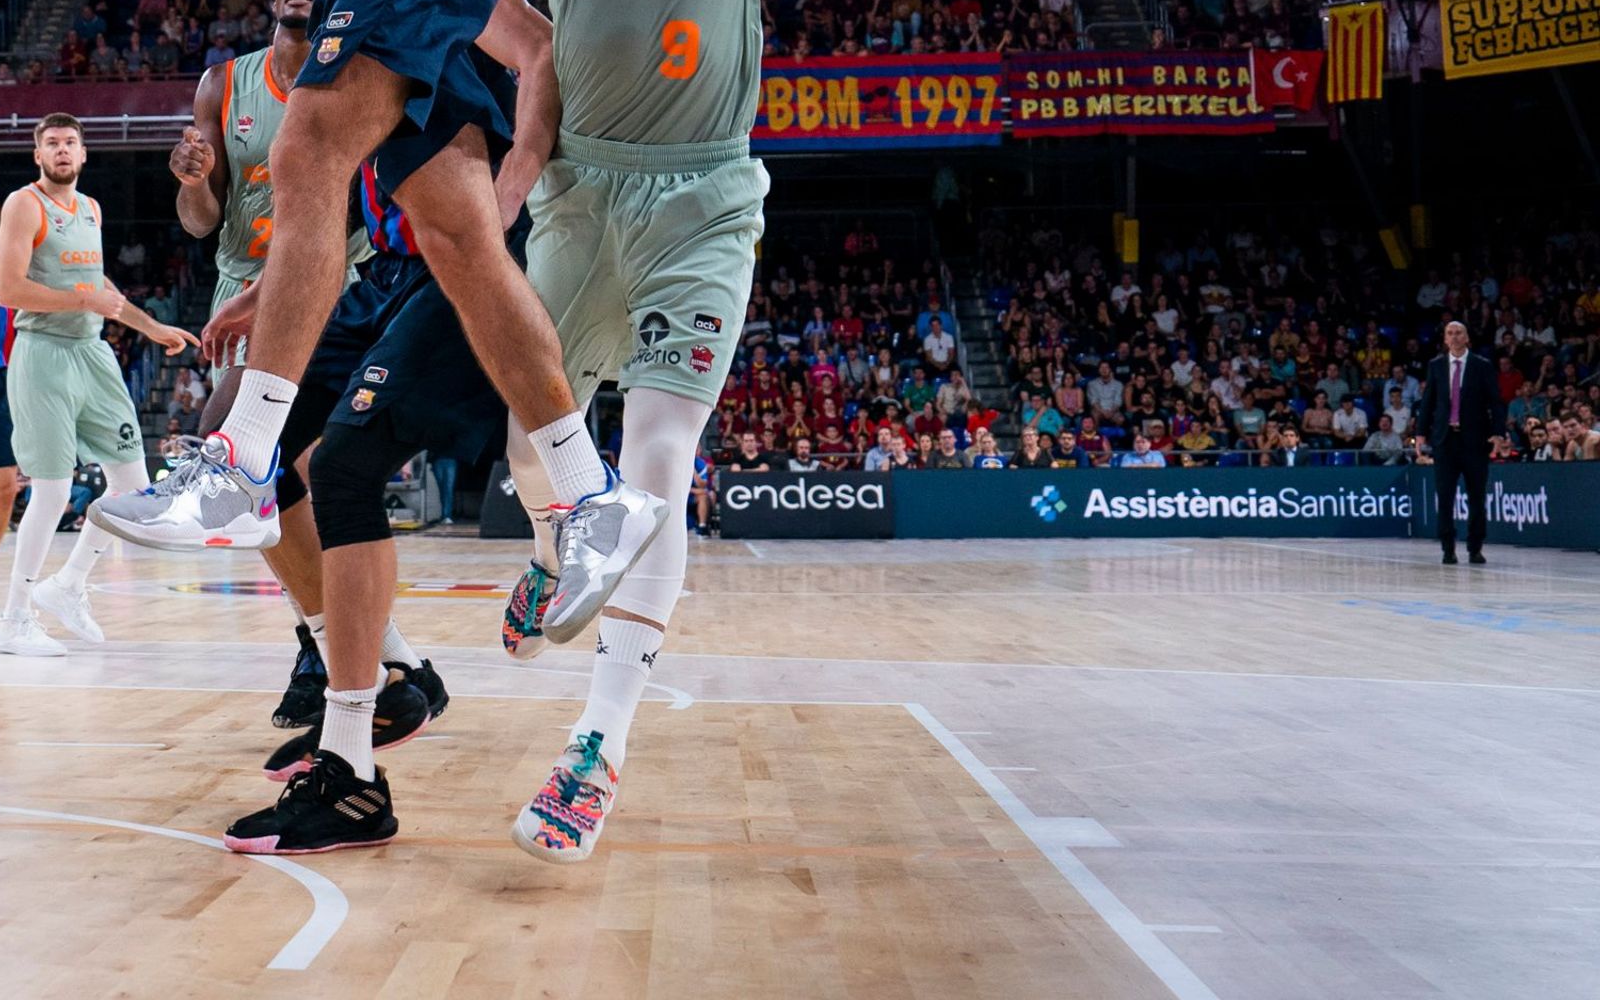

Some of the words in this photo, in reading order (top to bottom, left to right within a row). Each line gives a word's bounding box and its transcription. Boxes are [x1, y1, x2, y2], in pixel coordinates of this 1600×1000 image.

[1026, 67, 1124, 90] SOM-HI
[1153, 66, 1250, 89] BARÇA
[758, 76, 861, 131] BBM
[895, 76, 997, 129] 1997
[1021, 97, 1079, 120] PBB
[1086, 93, 1264, 117] MERITXELL
[696, 320, 716, 331] acb
[726, 477, 884, 510] endesa
[1495, 481, 1548, 532] l'esport
